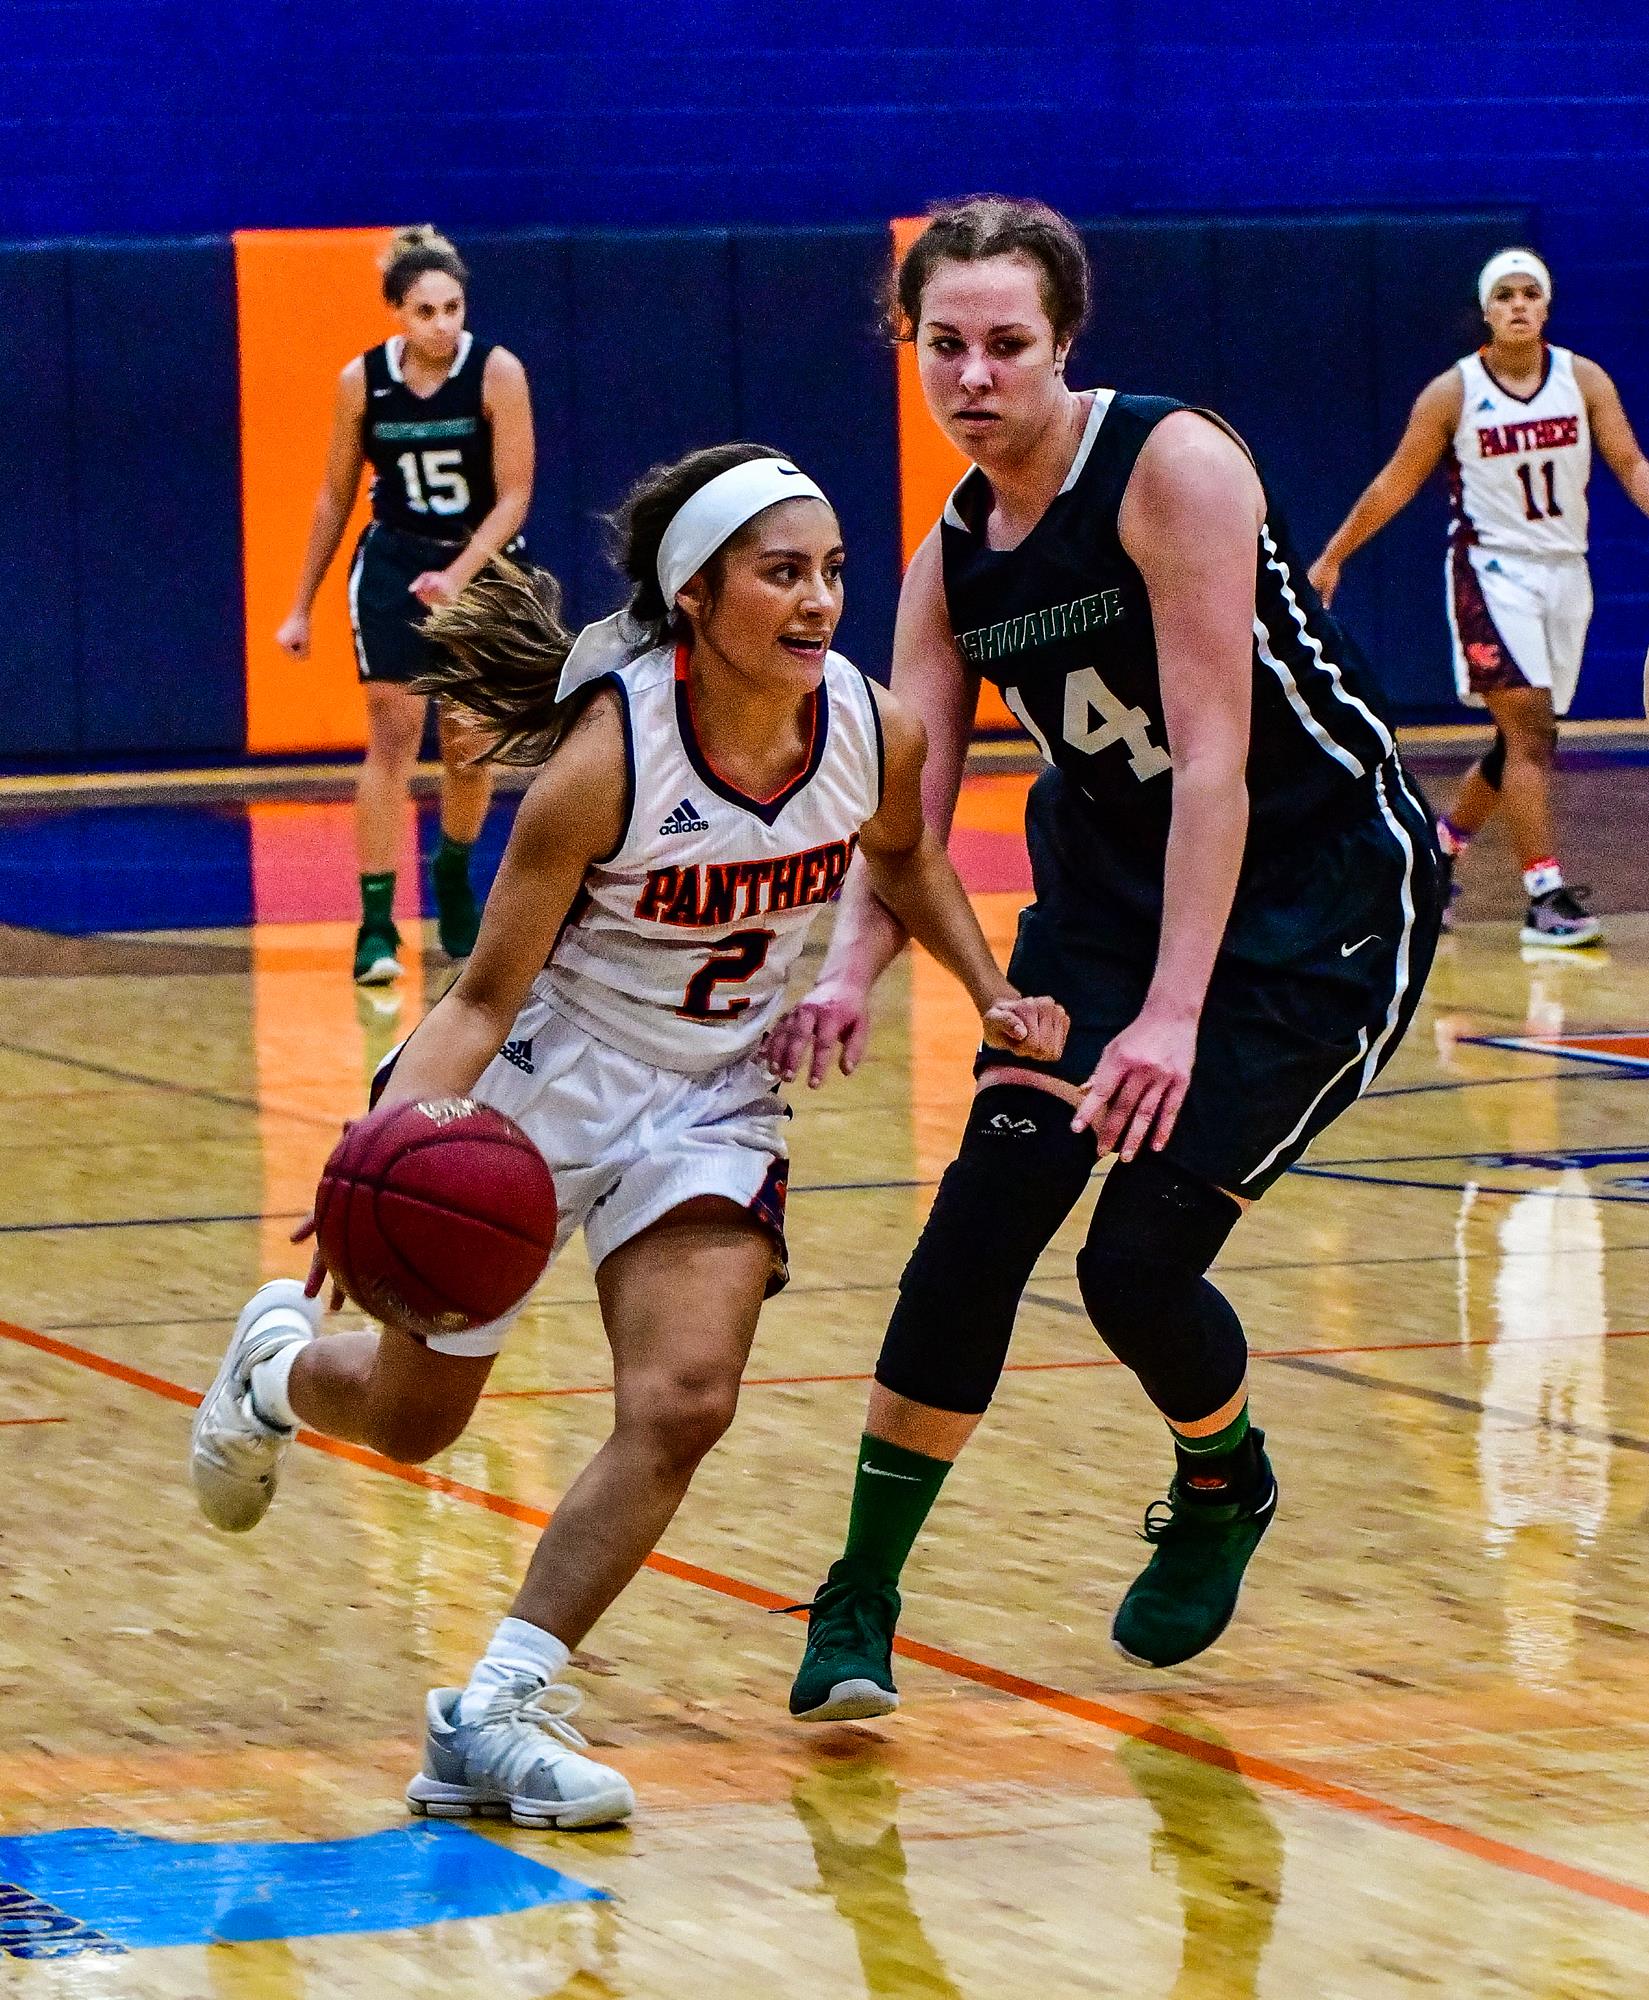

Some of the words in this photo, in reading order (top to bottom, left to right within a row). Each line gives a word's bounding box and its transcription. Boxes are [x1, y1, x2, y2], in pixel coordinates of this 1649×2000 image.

[397, 449, 471, 515] 15
[1517, 461, 1562, 520] 11
[1005, 666, 1173, 783] 14
[659, 820, 709, 835] adidas
[675, 928, 776, 1021] 2
